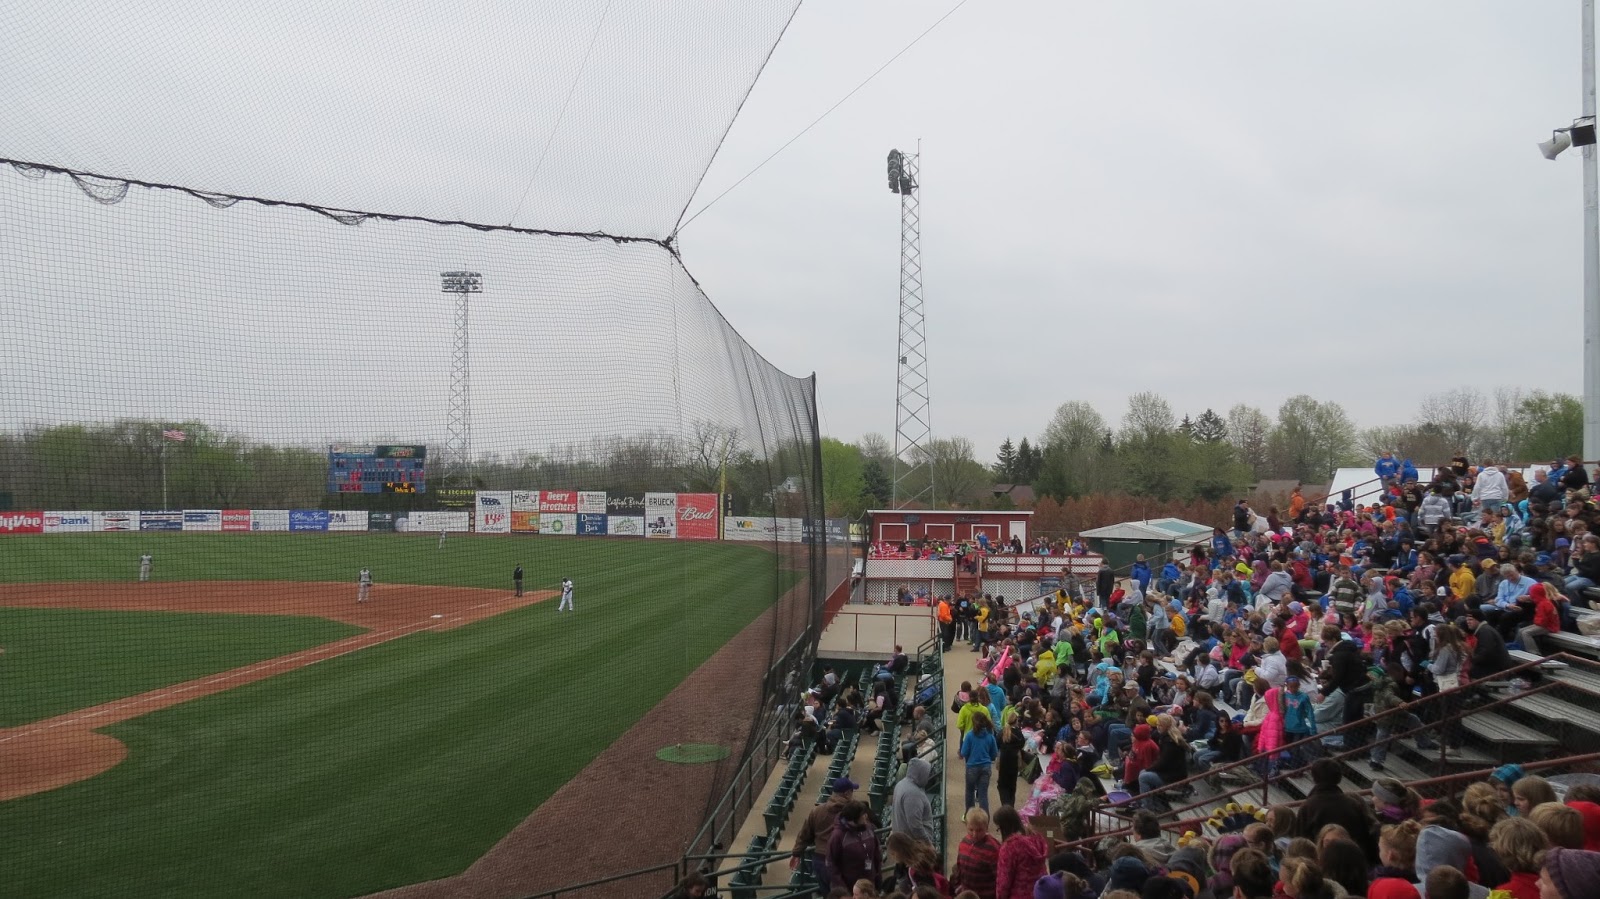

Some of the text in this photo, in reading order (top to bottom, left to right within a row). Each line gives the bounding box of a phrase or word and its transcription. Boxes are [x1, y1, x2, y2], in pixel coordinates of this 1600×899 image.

[649, 498, 675, 506] BRUECK
[540, 502, 576, 511] Brothers
[678, 506, 715, 520] Bud
[61, 517, 90, 525] bank
